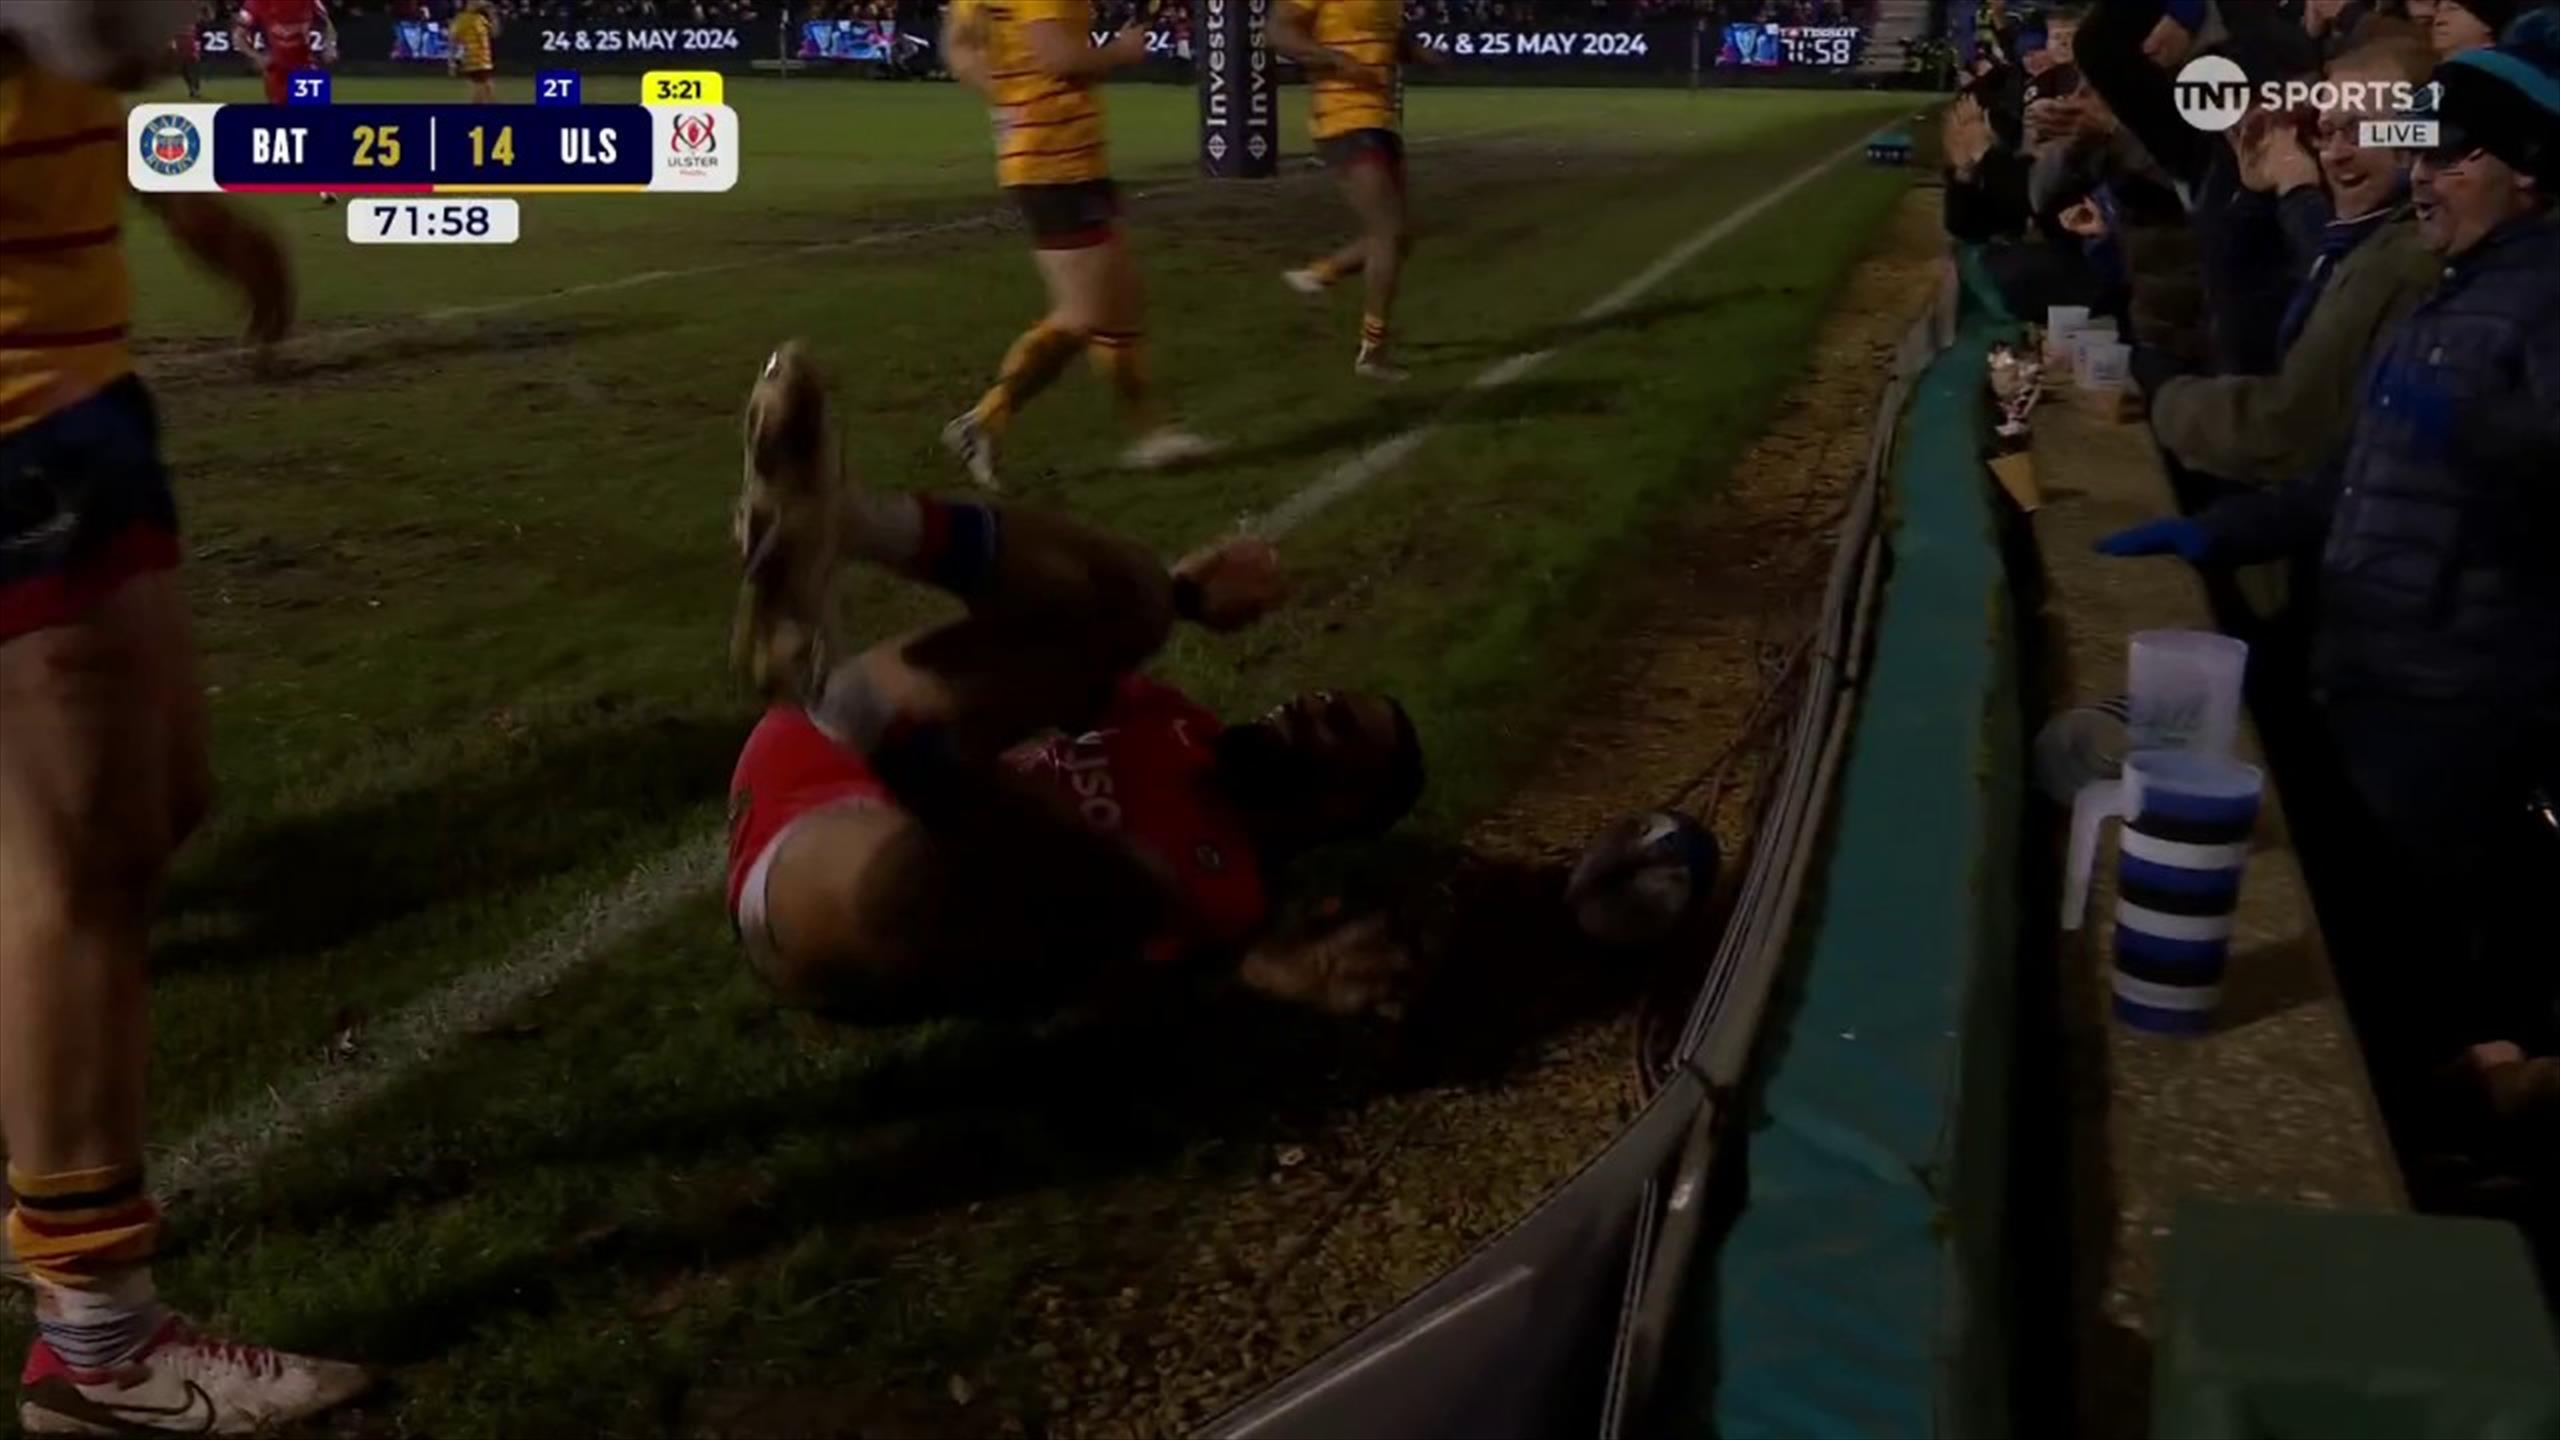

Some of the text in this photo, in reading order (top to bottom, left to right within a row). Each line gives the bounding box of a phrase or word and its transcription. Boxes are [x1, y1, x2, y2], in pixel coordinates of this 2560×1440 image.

[541, 29, 740, 51] 24 & 25 MAY 2024
[1454, 32, 1474, 55] &
[1478, 33, 1511, 55] 25
[1516, 33, 1577, 55] MAY
[1582, 33, 1649, 55] 2024
